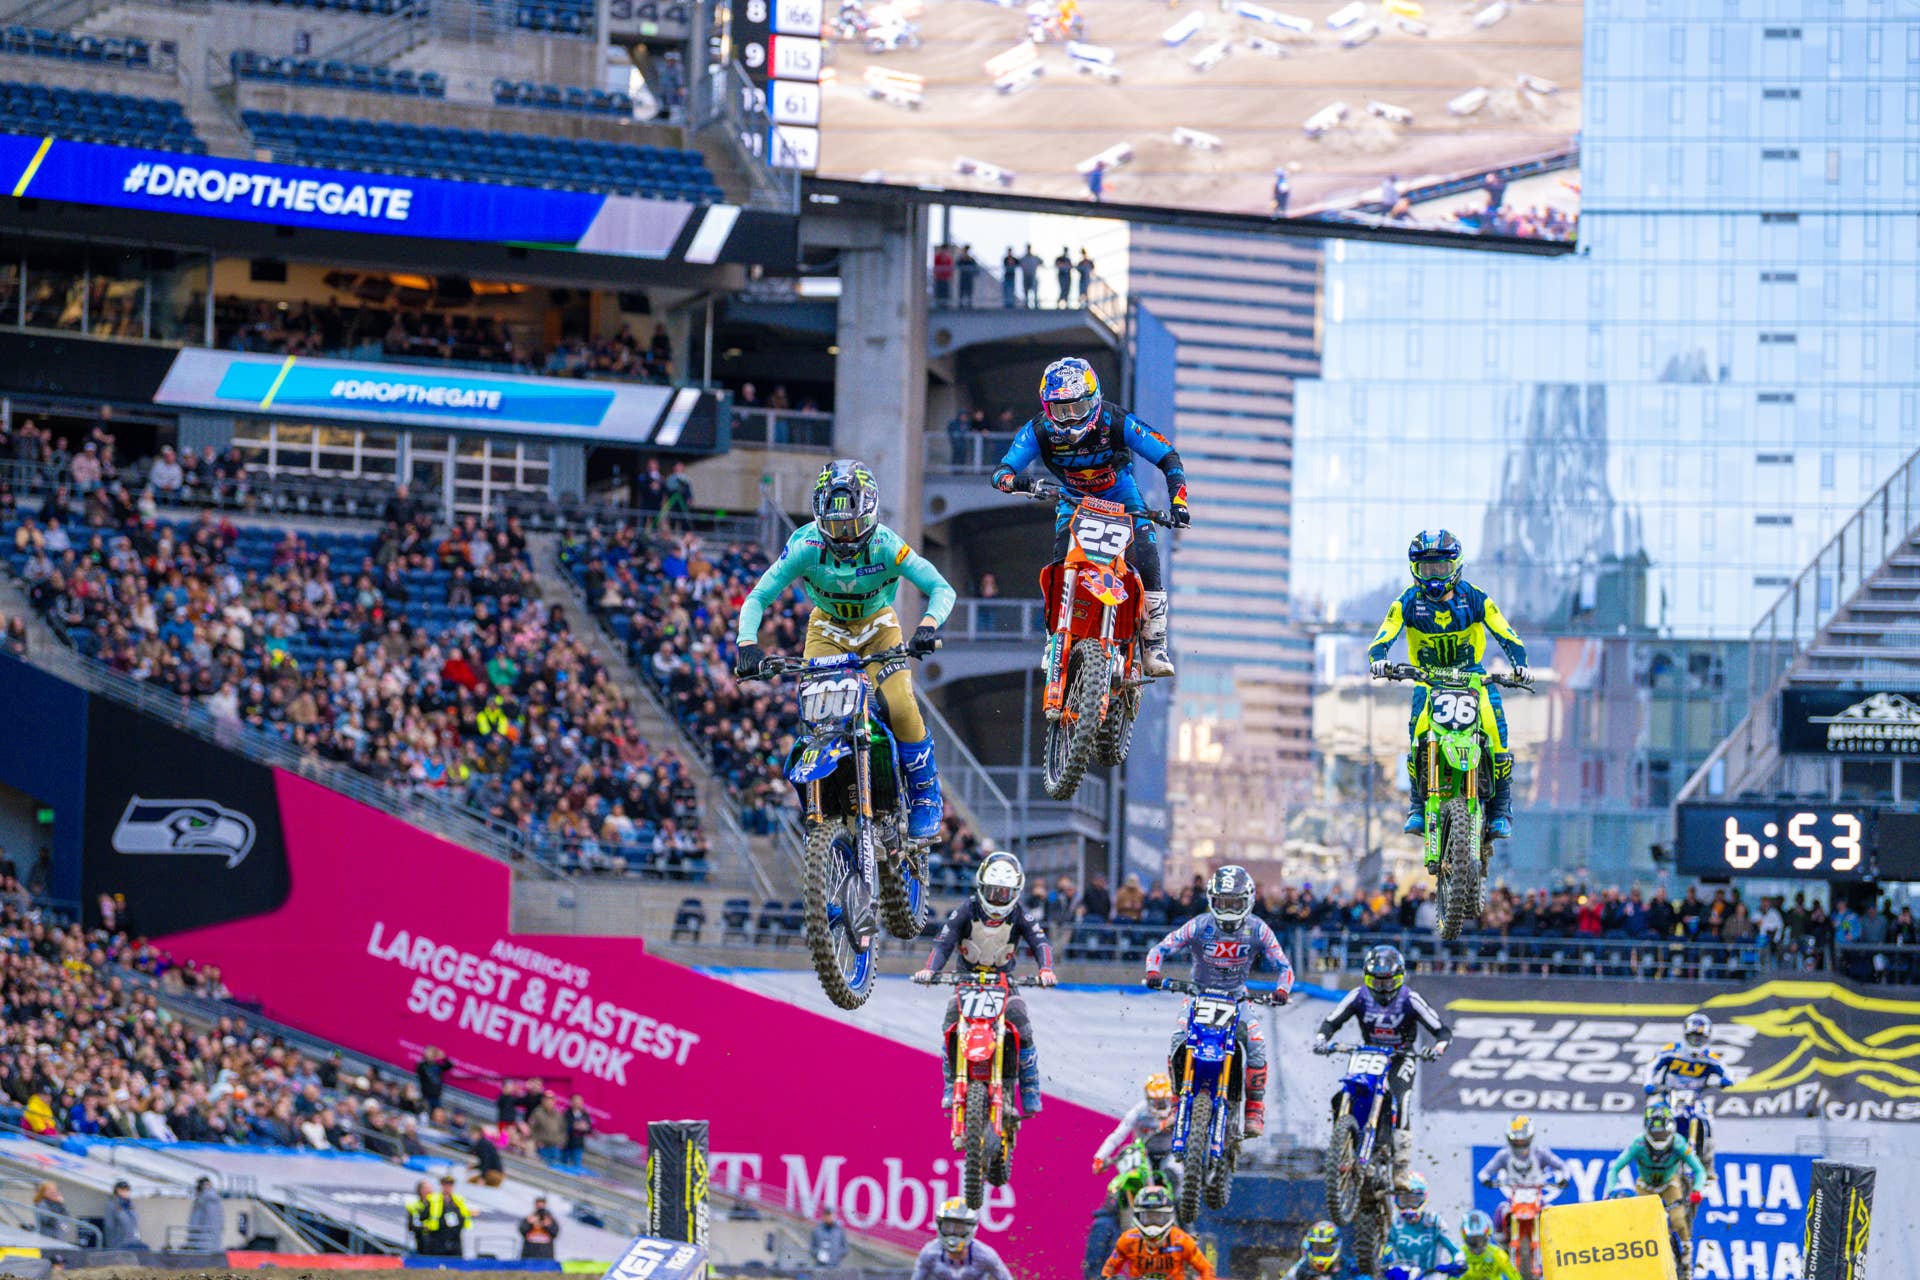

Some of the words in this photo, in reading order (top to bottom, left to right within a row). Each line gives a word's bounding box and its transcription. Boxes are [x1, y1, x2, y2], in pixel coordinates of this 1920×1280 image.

[746, 0, 767, 23] 8
[745, 42, 765, 68] 9
[785, 50, 811, 69] 115
[785, 96, 808, 113] 61
[124, 162, 412, 221] #DROPTHEGATE
[330, 380, 502, 411] #DROPTHEGATE
[1076, 518, 1132, 555] 23
[801, 678, 858, 722] 100
[1432, 694, 1477, 725] 36
[1826, 740, 1886, 752] CASINO
[1724, 812, 1862, 871] 6:53
[490, 939, 591, 989] AMERICA'S
[367, 921, 521, 1002] LARGEST
[520, 978, 547, 1015] &
[551, 987, 700, 1066] FASTEST
[961, 990, 1006, 1018] 115
[1193, 1002, 1236, 1026] 37
[407, 977, 456, 1022] 5G
[458, 995, 634, 1086] NETWORK
[1452, 1017, 1757, 1047] SUPER
[1669, 1059, 1707, 1078] FLY
[1459, 1086, 1636, 1113] WORLD
[653, 1148, 662, 1231] CHAMPIONSHIP
[780, 1153, 1016, 1233] Mobie
[1809, 1188, 1824, 1272] CHAMPIONSHIP
[1556, 1239, 1659, 1267] insta360
